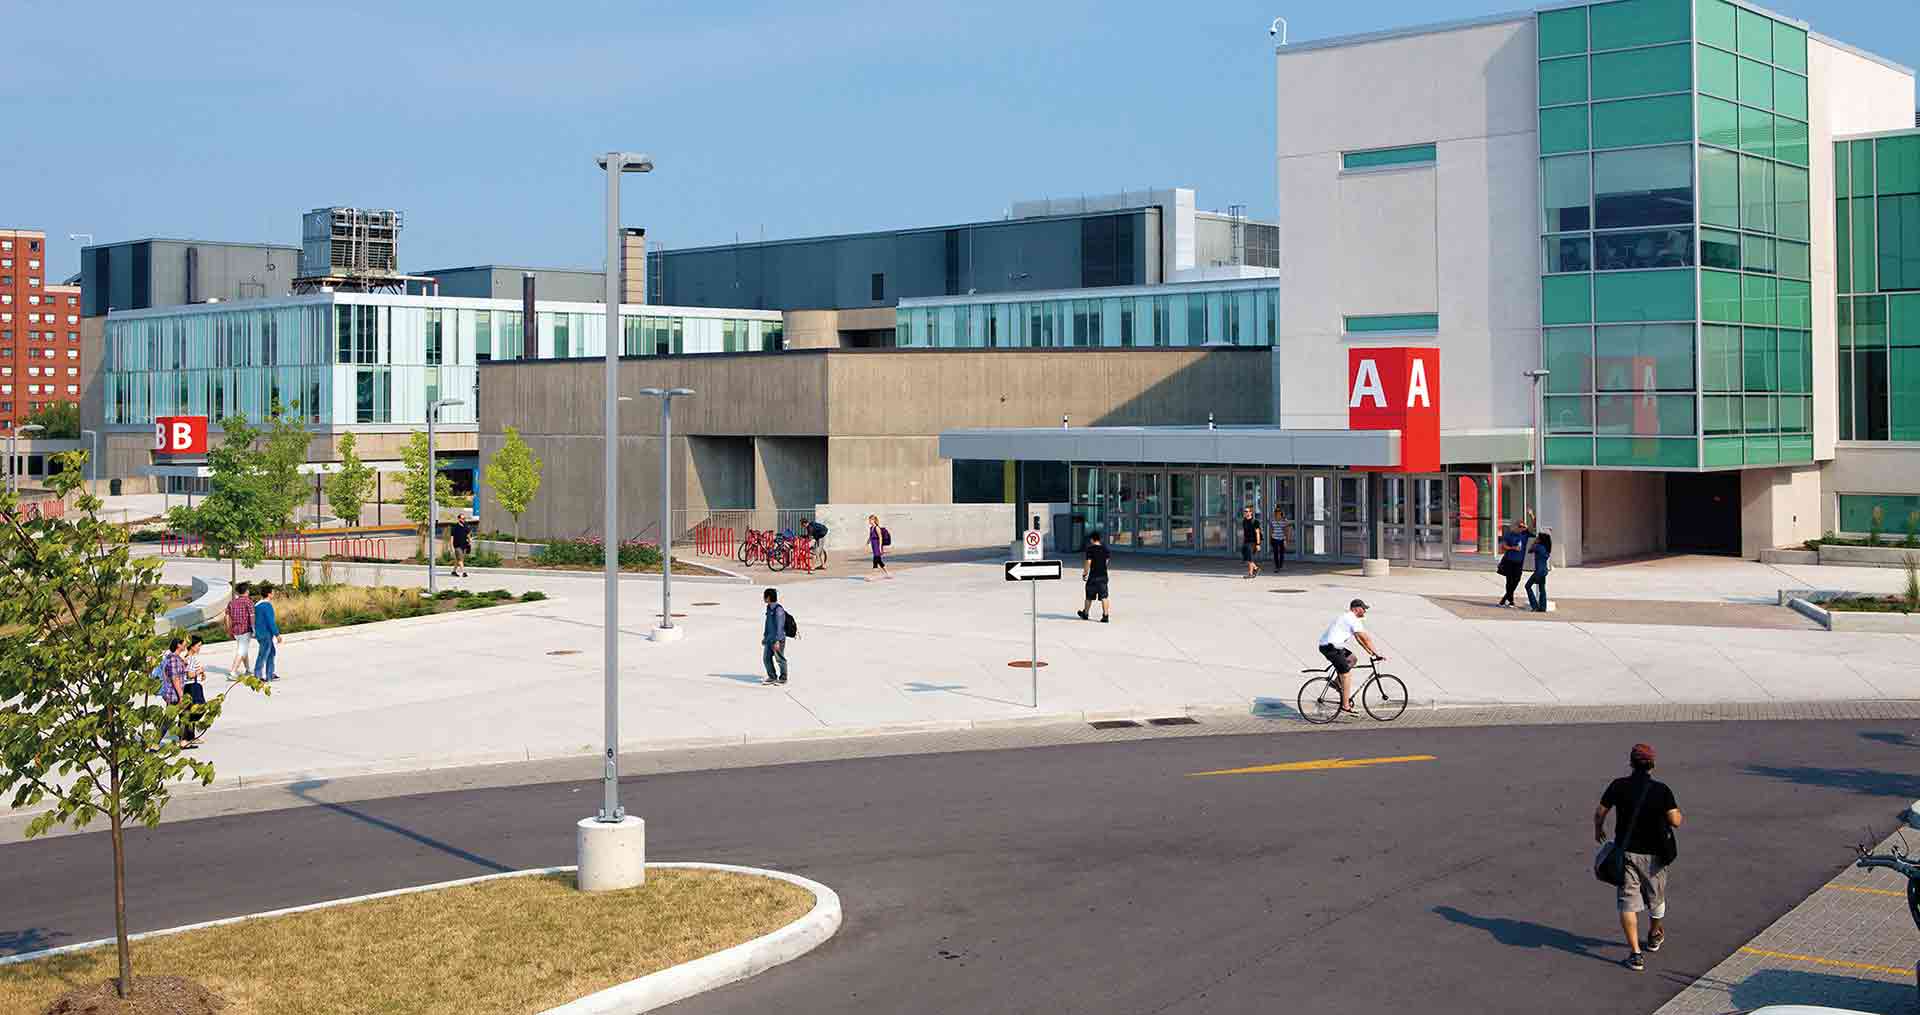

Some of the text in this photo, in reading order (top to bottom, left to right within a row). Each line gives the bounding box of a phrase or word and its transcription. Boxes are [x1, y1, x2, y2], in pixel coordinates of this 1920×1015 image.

[1349, 359, 1387, 407] A
[1407, 359, 1430, 407] A
[156, 423, 166, 449] B
[173, 422, 192, 449] B
